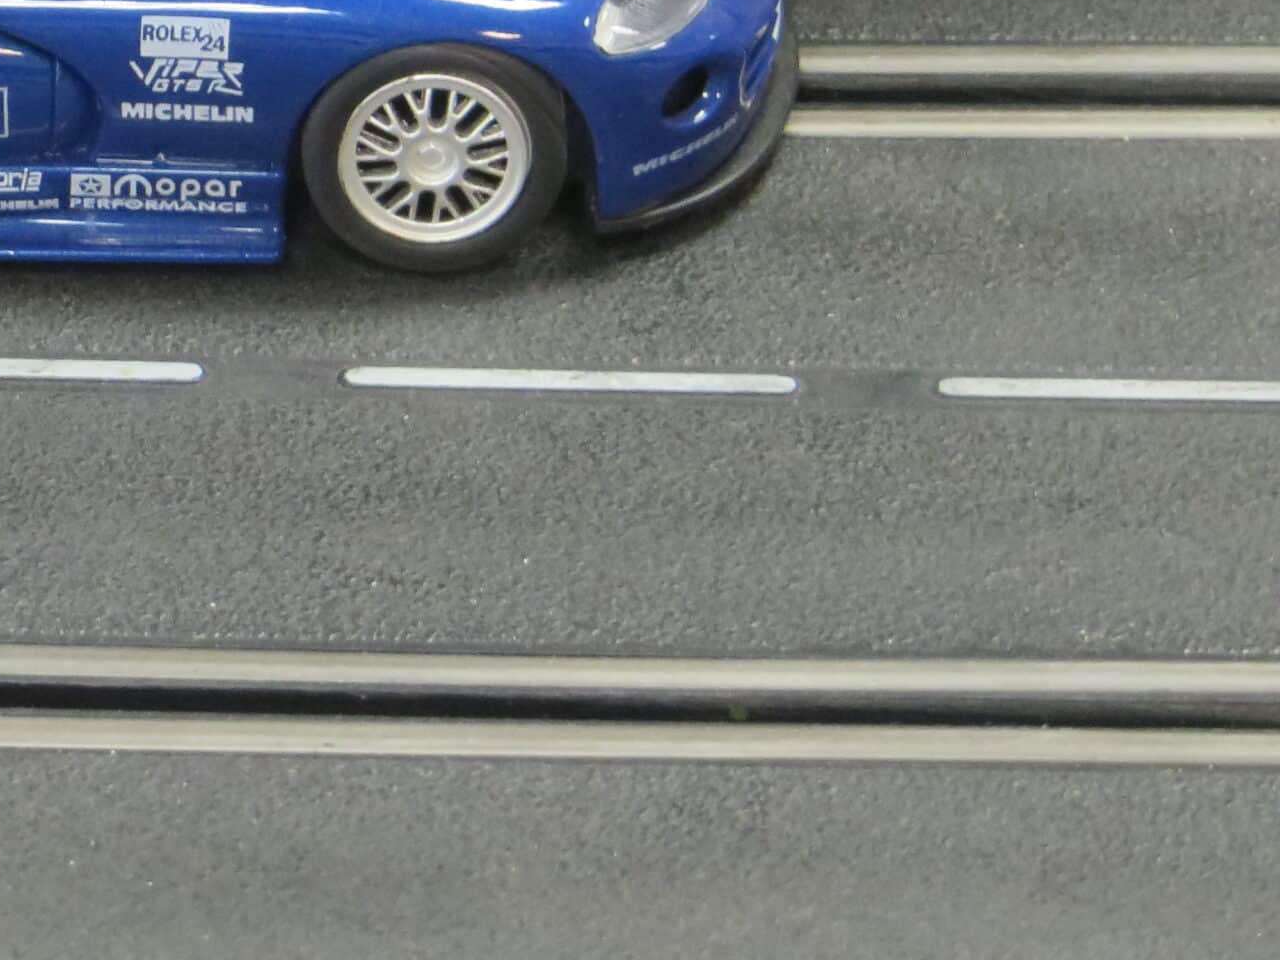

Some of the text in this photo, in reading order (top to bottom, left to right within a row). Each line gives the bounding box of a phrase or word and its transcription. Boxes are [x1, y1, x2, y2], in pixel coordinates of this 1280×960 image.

[142, 24, 226, 53] ROLEX 24
[120, 101, 255, 123] MICHELIN
[69, 196, 248, 214] PERFORMANCE
